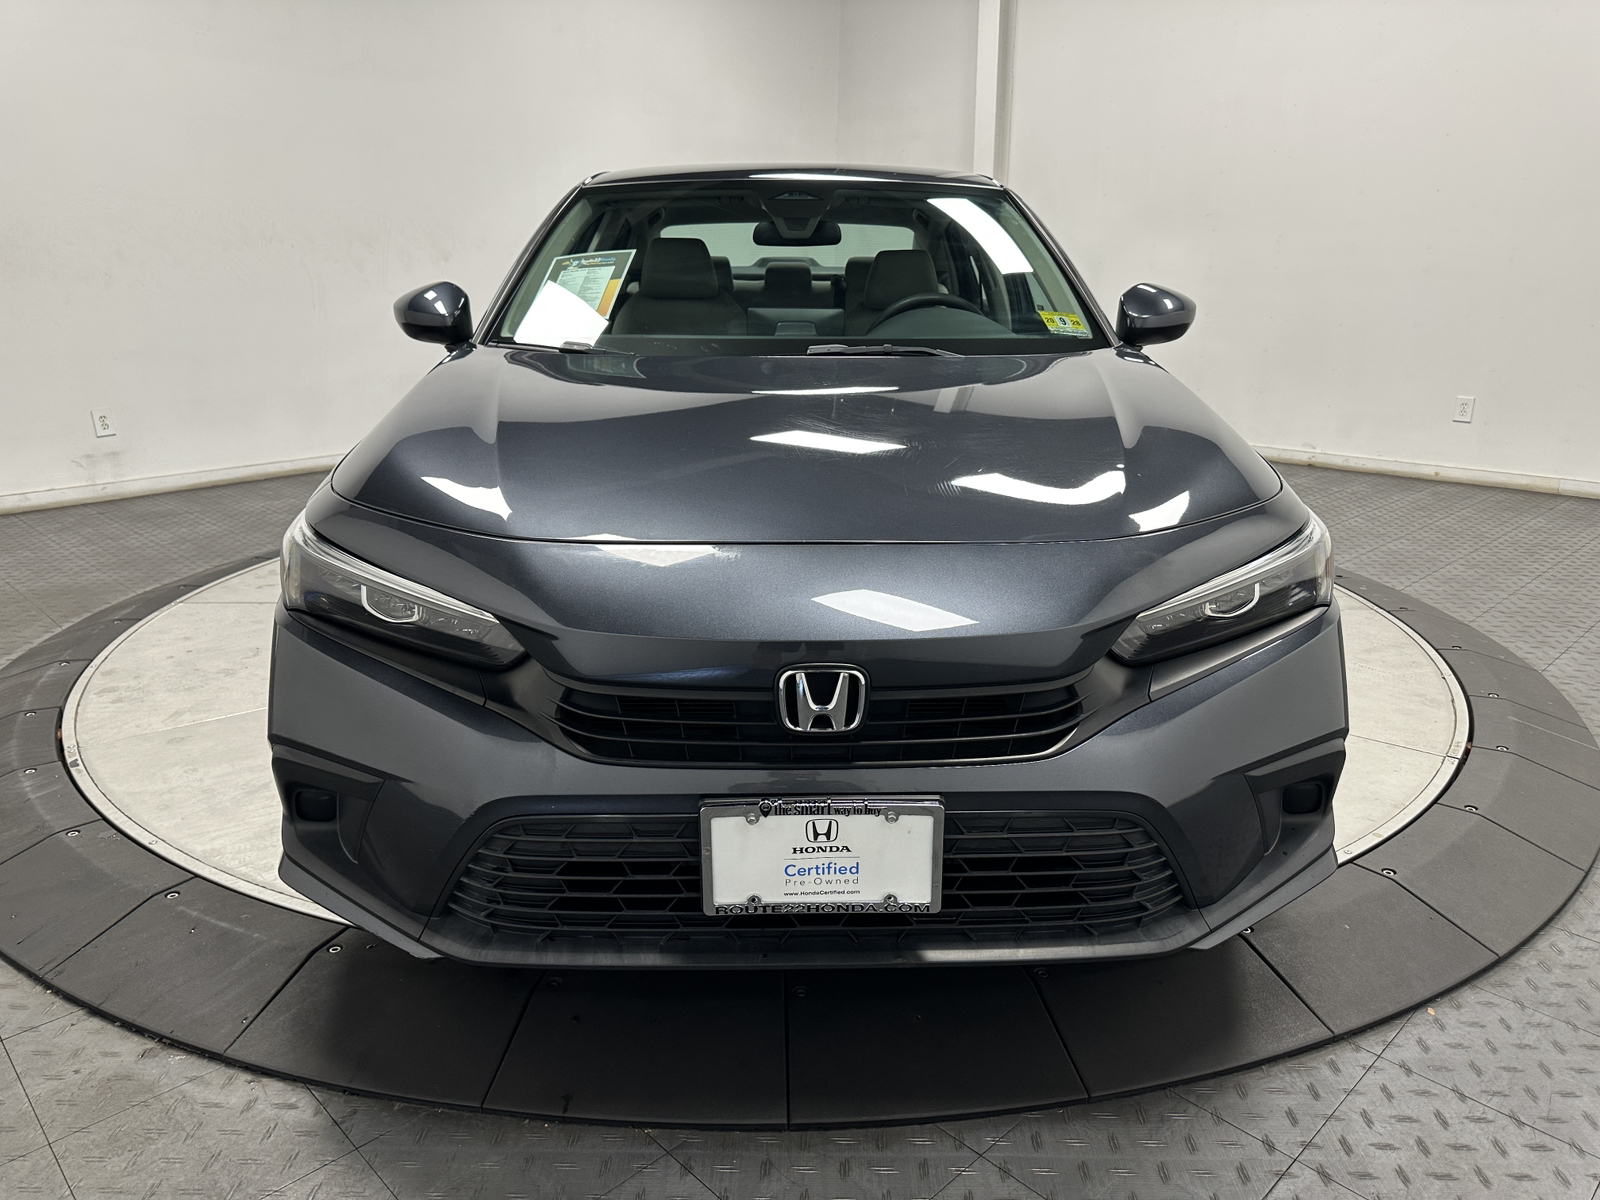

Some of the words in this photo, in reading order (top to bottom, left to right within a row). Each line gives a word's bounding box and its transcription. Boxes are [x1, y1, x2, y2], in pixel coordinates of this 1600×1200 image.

[1059, 317, 1067, 326] 9
[774, 799, 792, 816] the
[793, 799, 831, 816] smart
[833, 805, 852, 817] way
[853, 802, 862, 815] to
[864, 801, 883, 817] buy
[791, 845, 852, 855] HONDA
[784, 862, 860, 877] Certified
[785, 877, 859, 887] Pre-Owned
[715, 904, 931, 915] ROUTE22HONDA.COM
